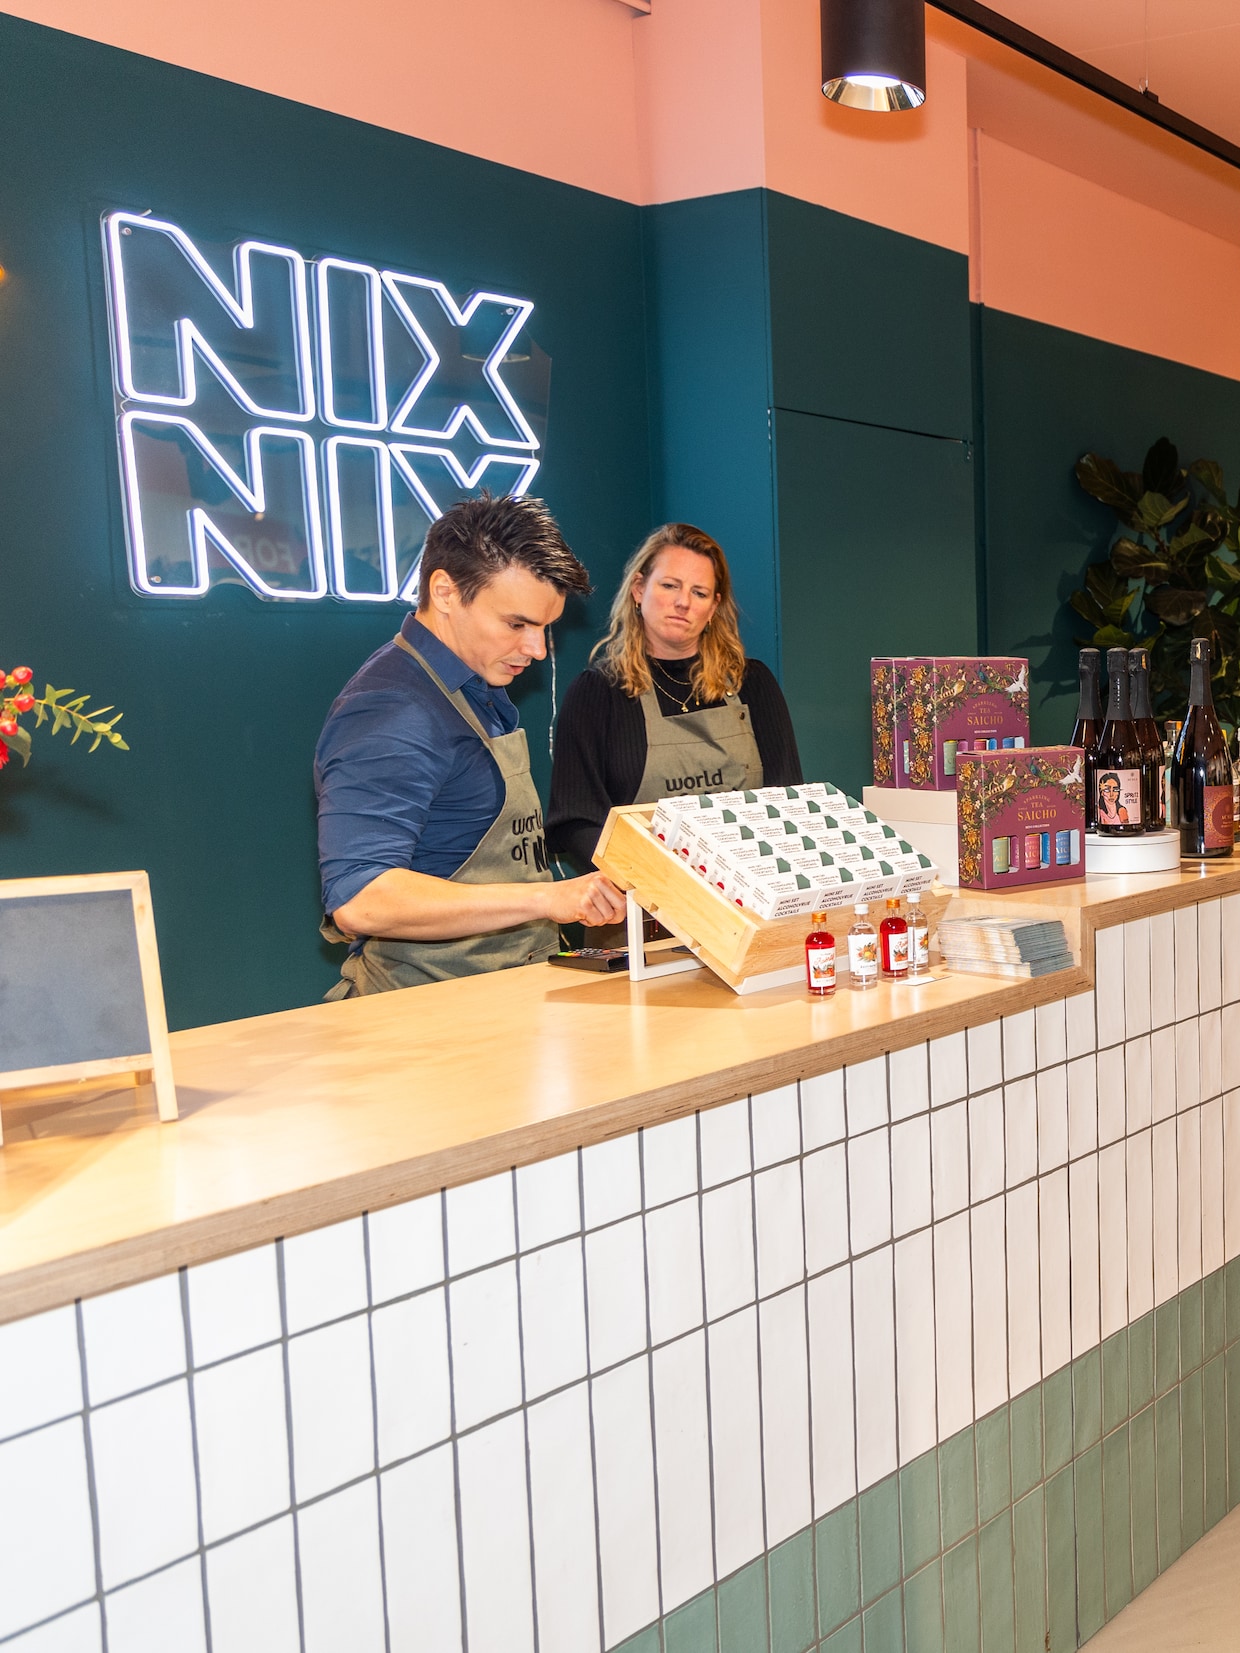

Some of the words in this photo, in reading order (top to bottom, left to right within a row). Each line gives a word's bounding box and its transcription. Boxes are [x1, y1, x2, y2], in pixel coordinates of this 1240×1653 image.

[102, 211, 541, 450] NIX
[967, 715, 1004, 726] SAICHO
[665, 768, 724, 792] world
[512, 809, 544, 836] worl
[1017, 809, 1057, 821] SAICHO
[511, 837, 529, 865] of
